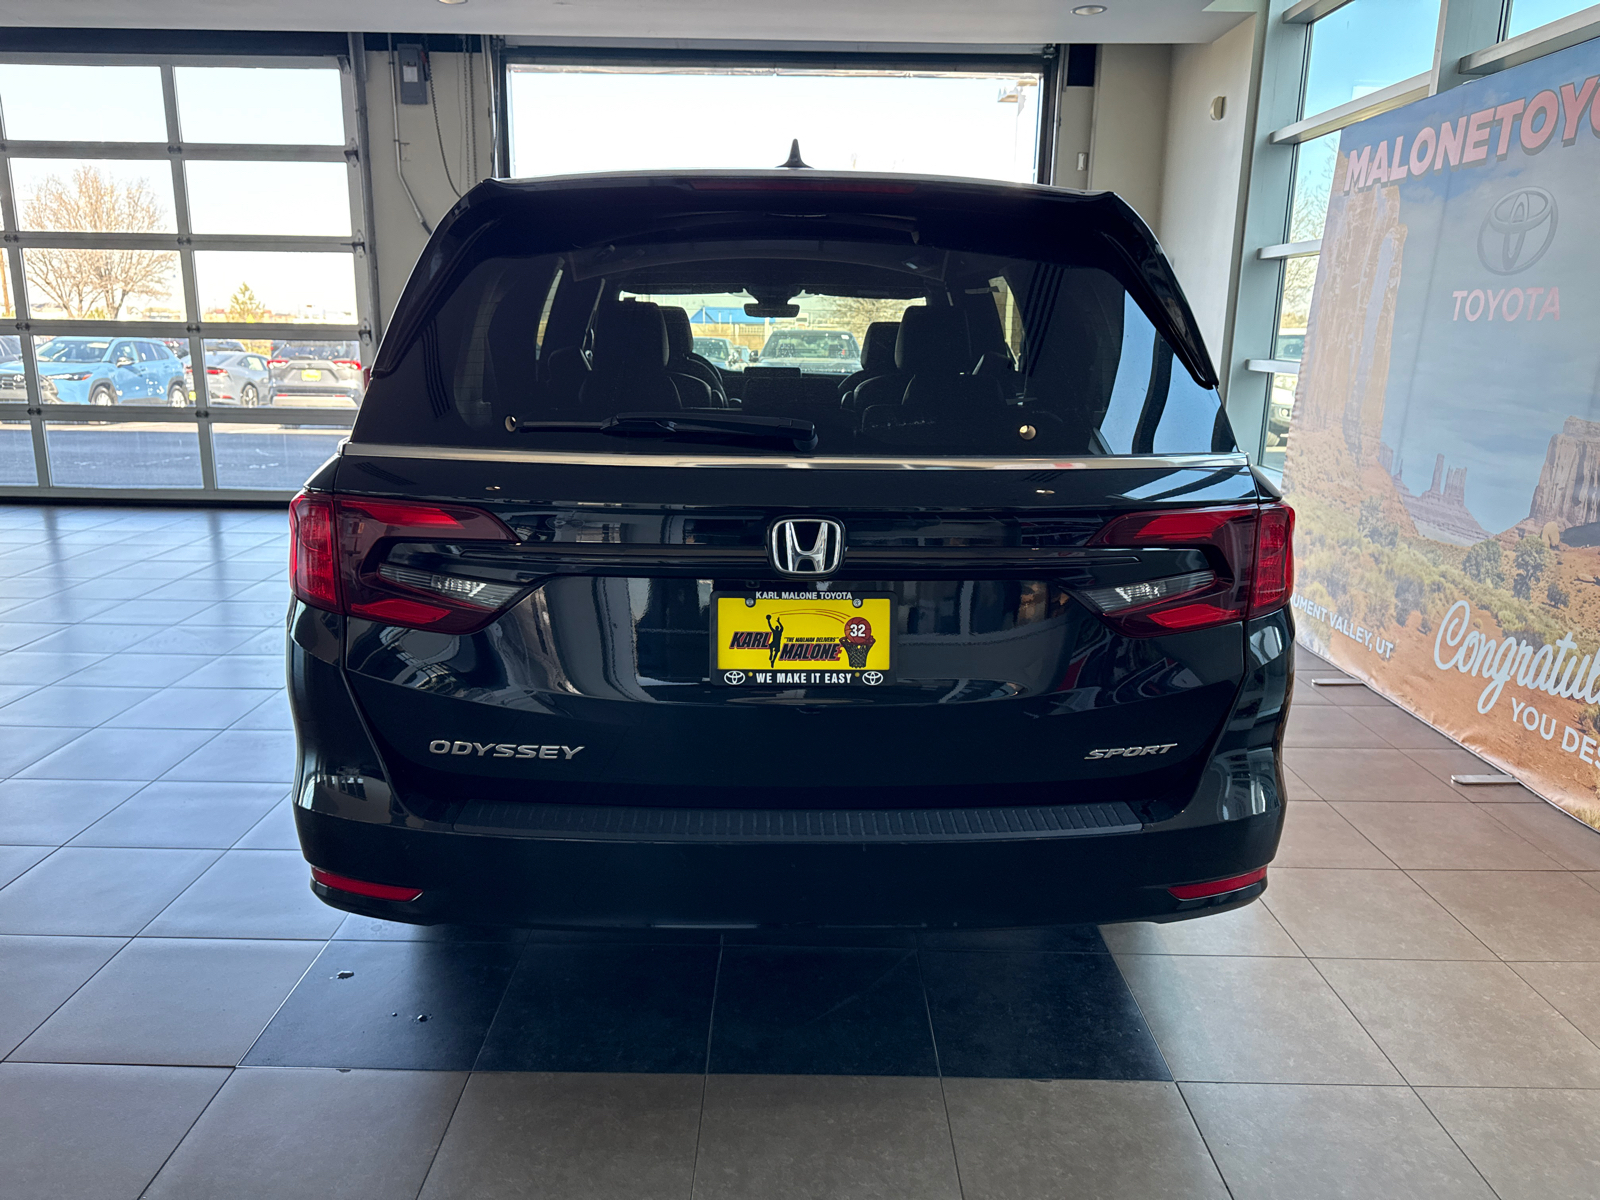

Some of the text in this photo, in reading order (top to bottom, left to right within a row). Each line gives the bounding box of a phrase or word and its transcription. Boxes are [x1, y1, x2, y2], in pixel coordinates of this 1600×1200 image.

[1343, 75, 1600, 194] MALONETOY
[1452, 287, 1561, 322] TOYOTA
[756, 591, 853, 600] KARL MALONE TOYOTA
[849, 624, 866, 637] 32
[1329, 611, 1373, 652] VALLEY,
[1375, 636, 1394, 659] UT
[729, 631, 843, 662] KARL MALONE
[756, 673, 852, 684] WE MAKE IT EASY
[1511, 697, 1557, 741] YOU
[429, 739, 585, 760] ODYSSEY
[1083, 742, 1178, 760] SPORT
